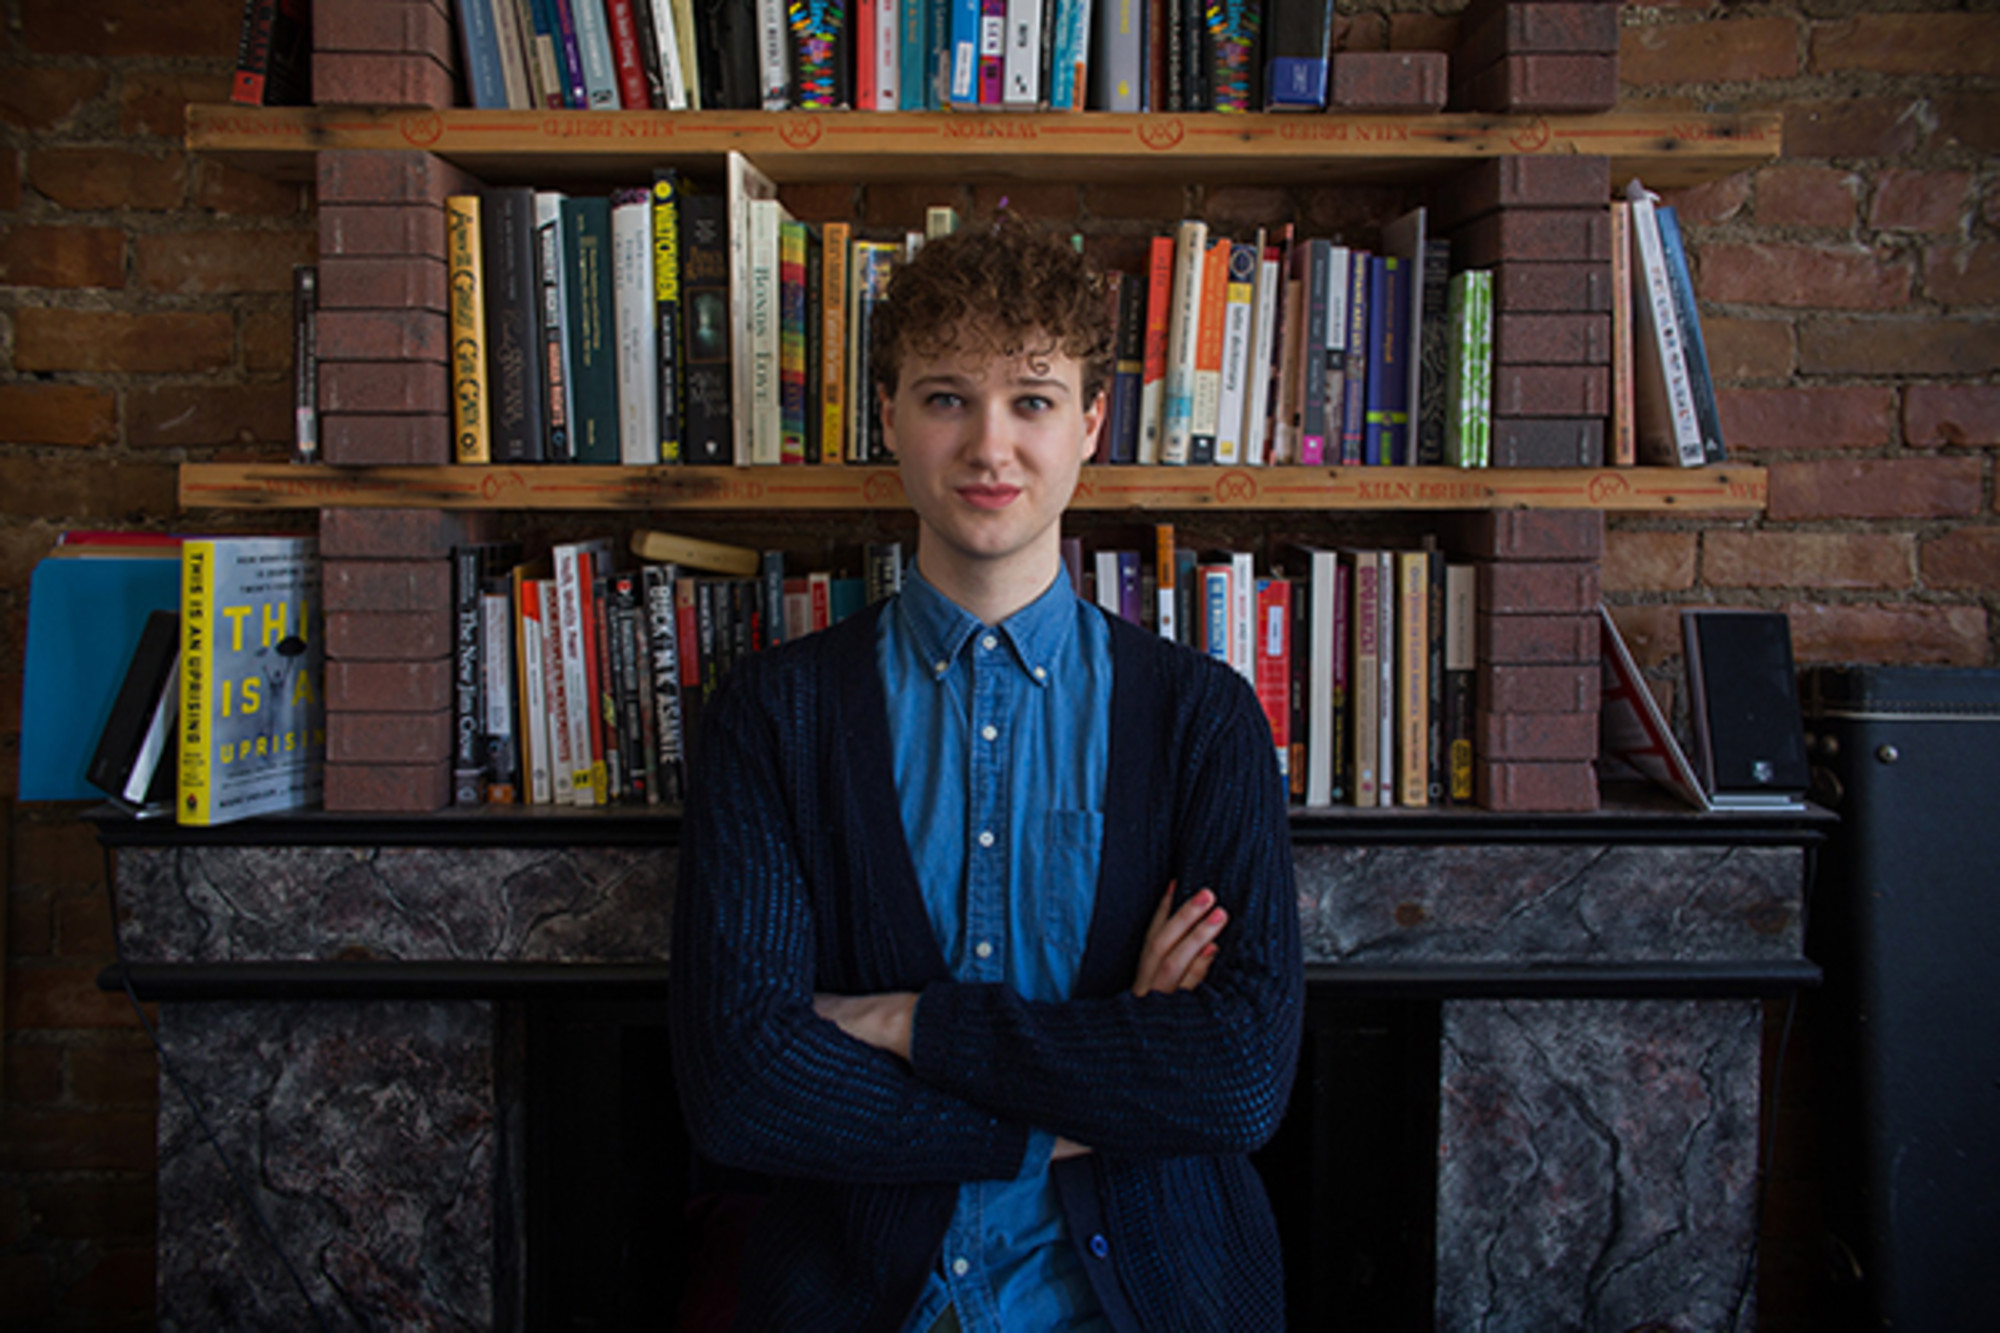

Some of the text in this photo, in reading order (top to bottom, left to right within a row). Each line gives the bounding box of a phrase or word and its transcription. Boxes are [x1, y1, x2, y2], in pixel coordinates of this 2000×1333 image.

[542, 118, 676, 138] KILN DRIED
[942, 121, 1038, 139] WINTON
[1279, 122, 1412, 141] KILN DRIED
[655, 203, 679, 301] WATCHMEN
[1357, 482, 1413, 499] KILN
[188, 553, 204, 593] THIS
[189, 600, 204, 618] IS
[222, 600, 327, 652] THI
[458, 610, 478, 641] The
[649, 585, 672, 638] BUCK
[188, 626, 203, 651] AN
[458, 644, 477, 681] New
[186, 656, 202, 744] UPRISING
[221, 675, 262, 718] IS
[219, 729, 326, 764] UPRISIN
[459, 715, 477, 760] Crow
[657, 692, 684, 764] ASANTE
